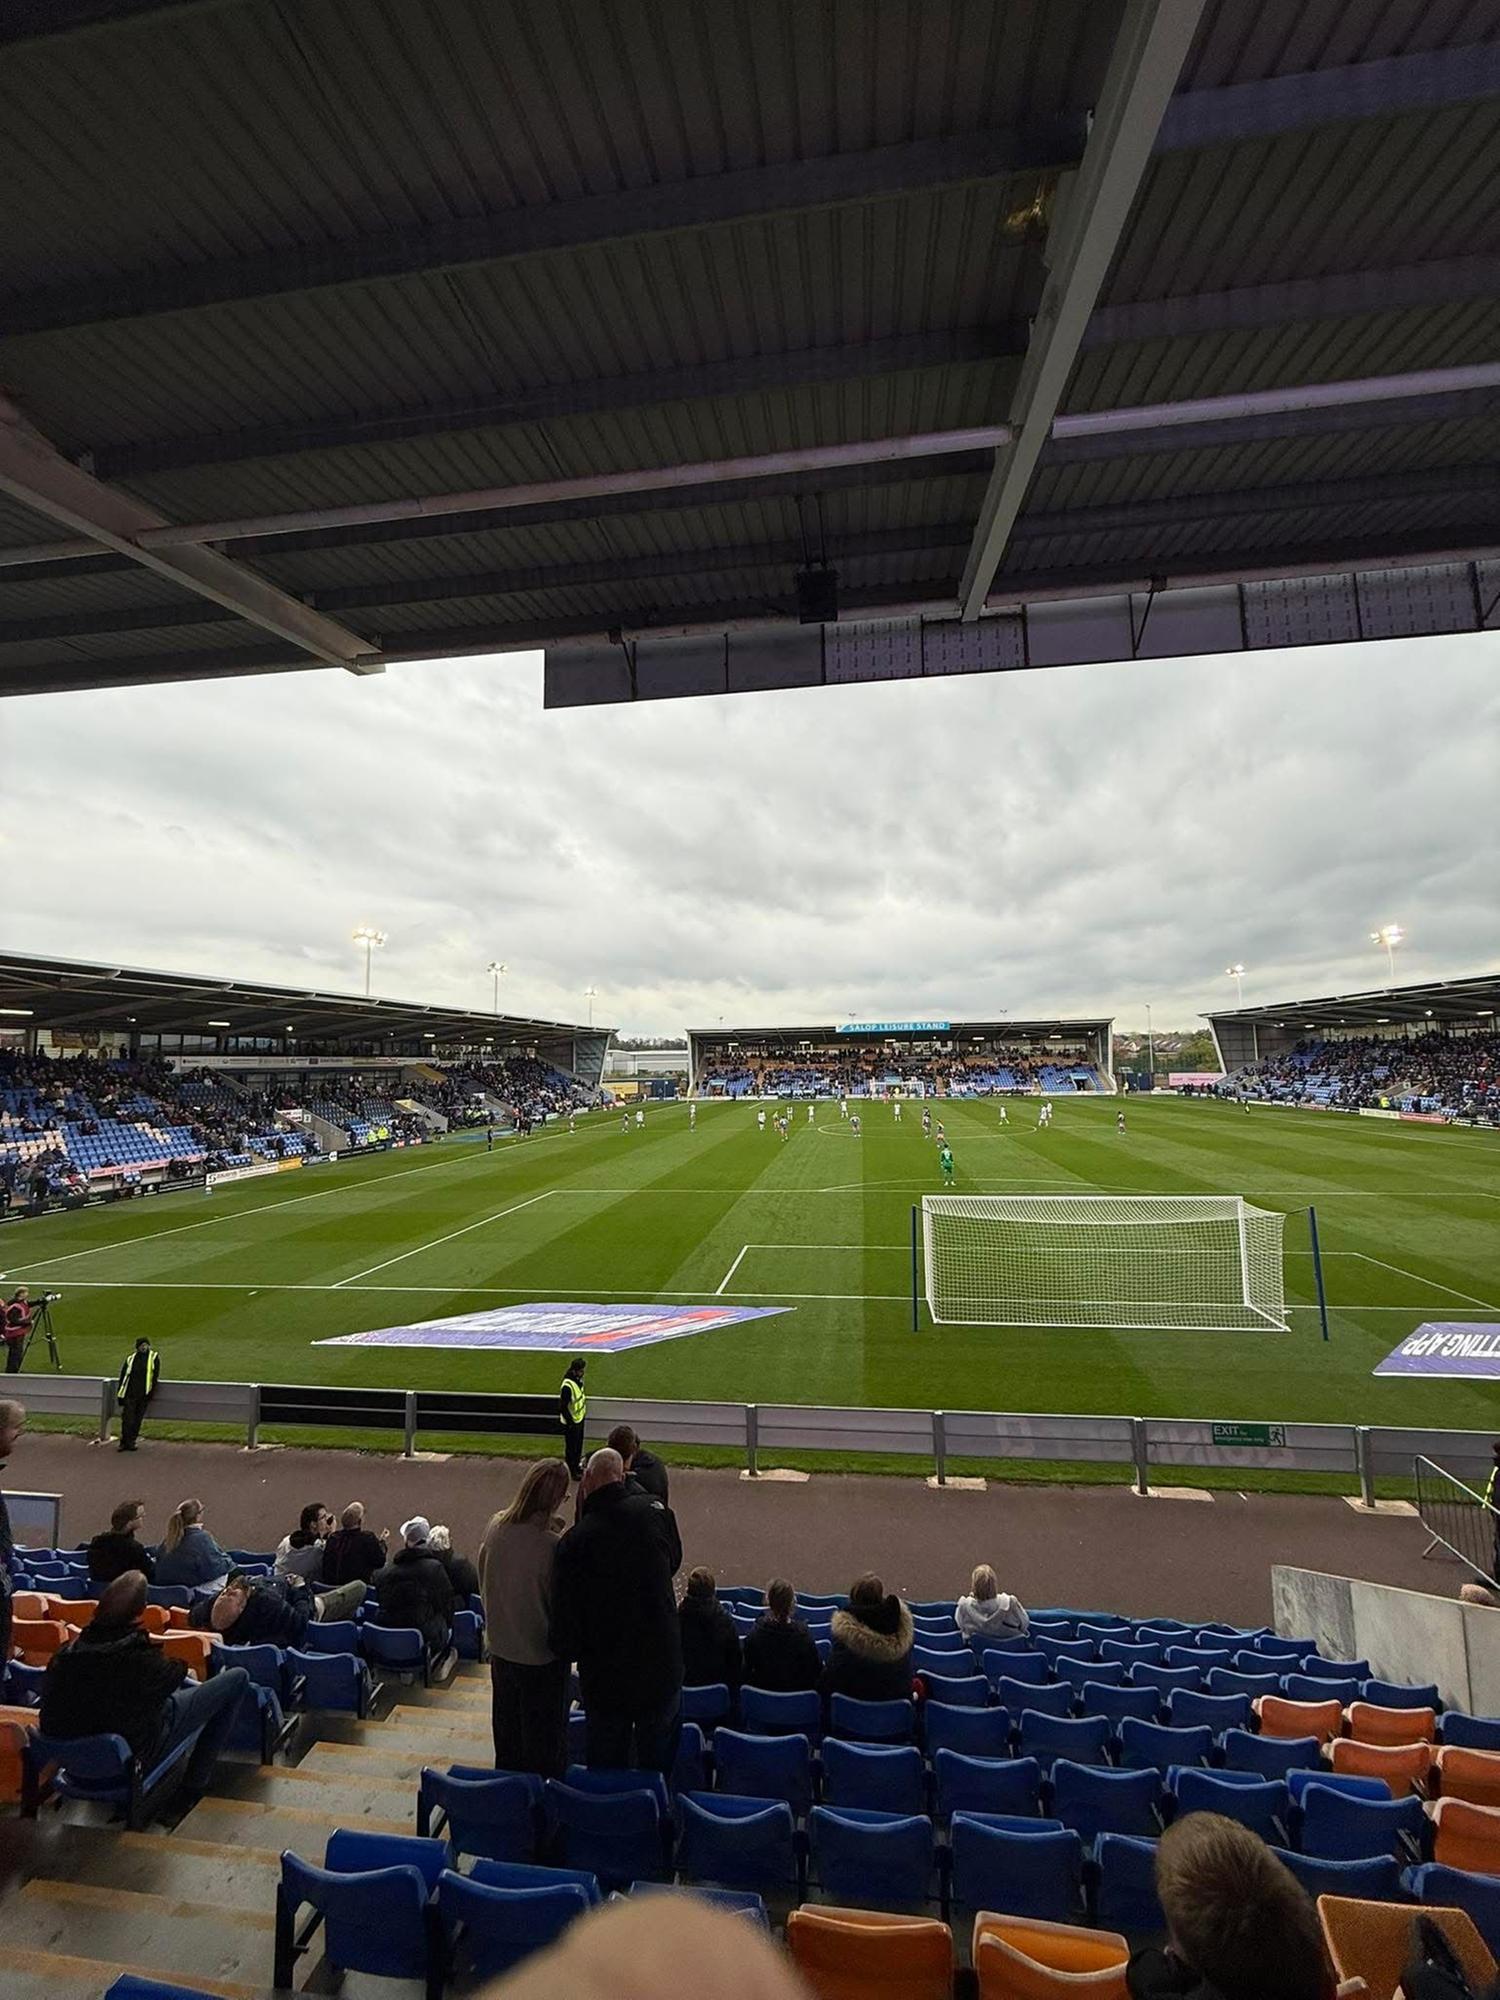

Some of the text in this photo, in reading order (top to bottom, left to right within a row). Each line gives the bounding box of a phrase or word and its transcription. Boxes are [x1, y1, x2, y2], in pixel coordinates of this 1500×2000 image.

[1401, 1333, 1500, 1357] TTING APP
[1214, 1425, 1239, 1435] EXIT
